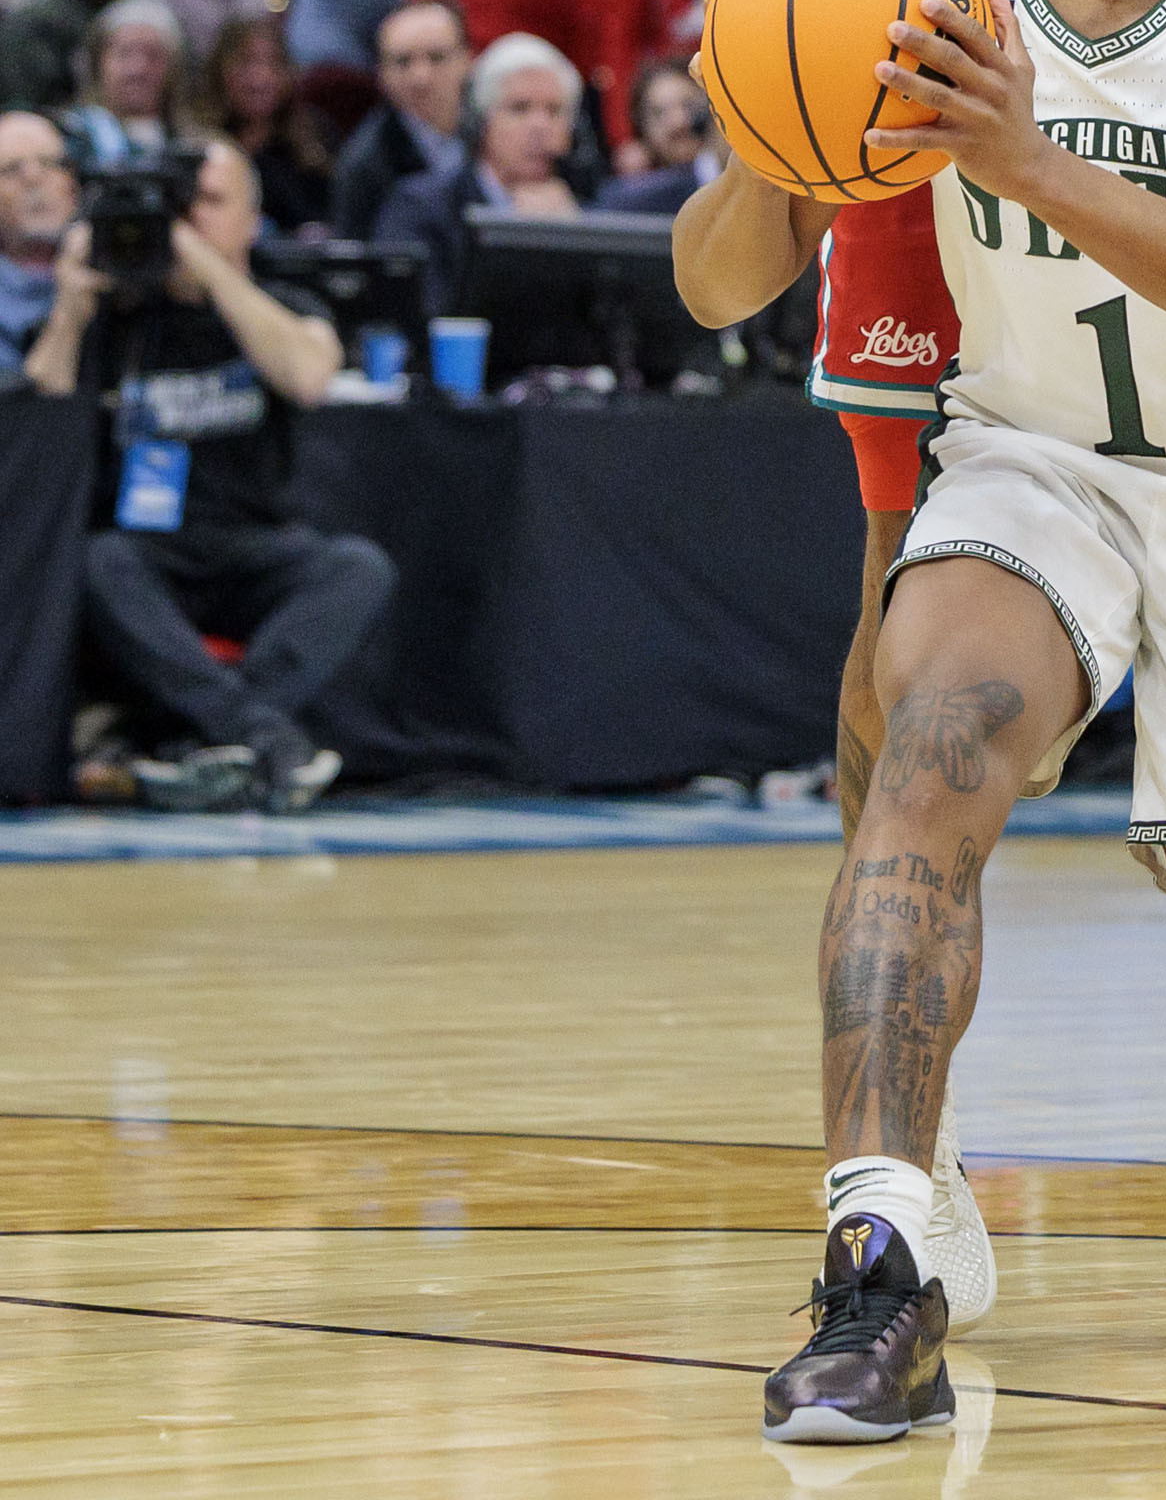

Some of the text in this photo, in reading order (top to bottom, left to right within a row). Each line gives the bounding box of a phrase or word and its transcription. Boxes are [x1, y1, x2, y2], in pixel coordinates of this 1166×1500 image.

[850, 316, 939, 367] Lobos
[1075, 294, 1166, 458] 1
[905, 851, 945, 892] The
[862, 891, 921, 924] Odds
